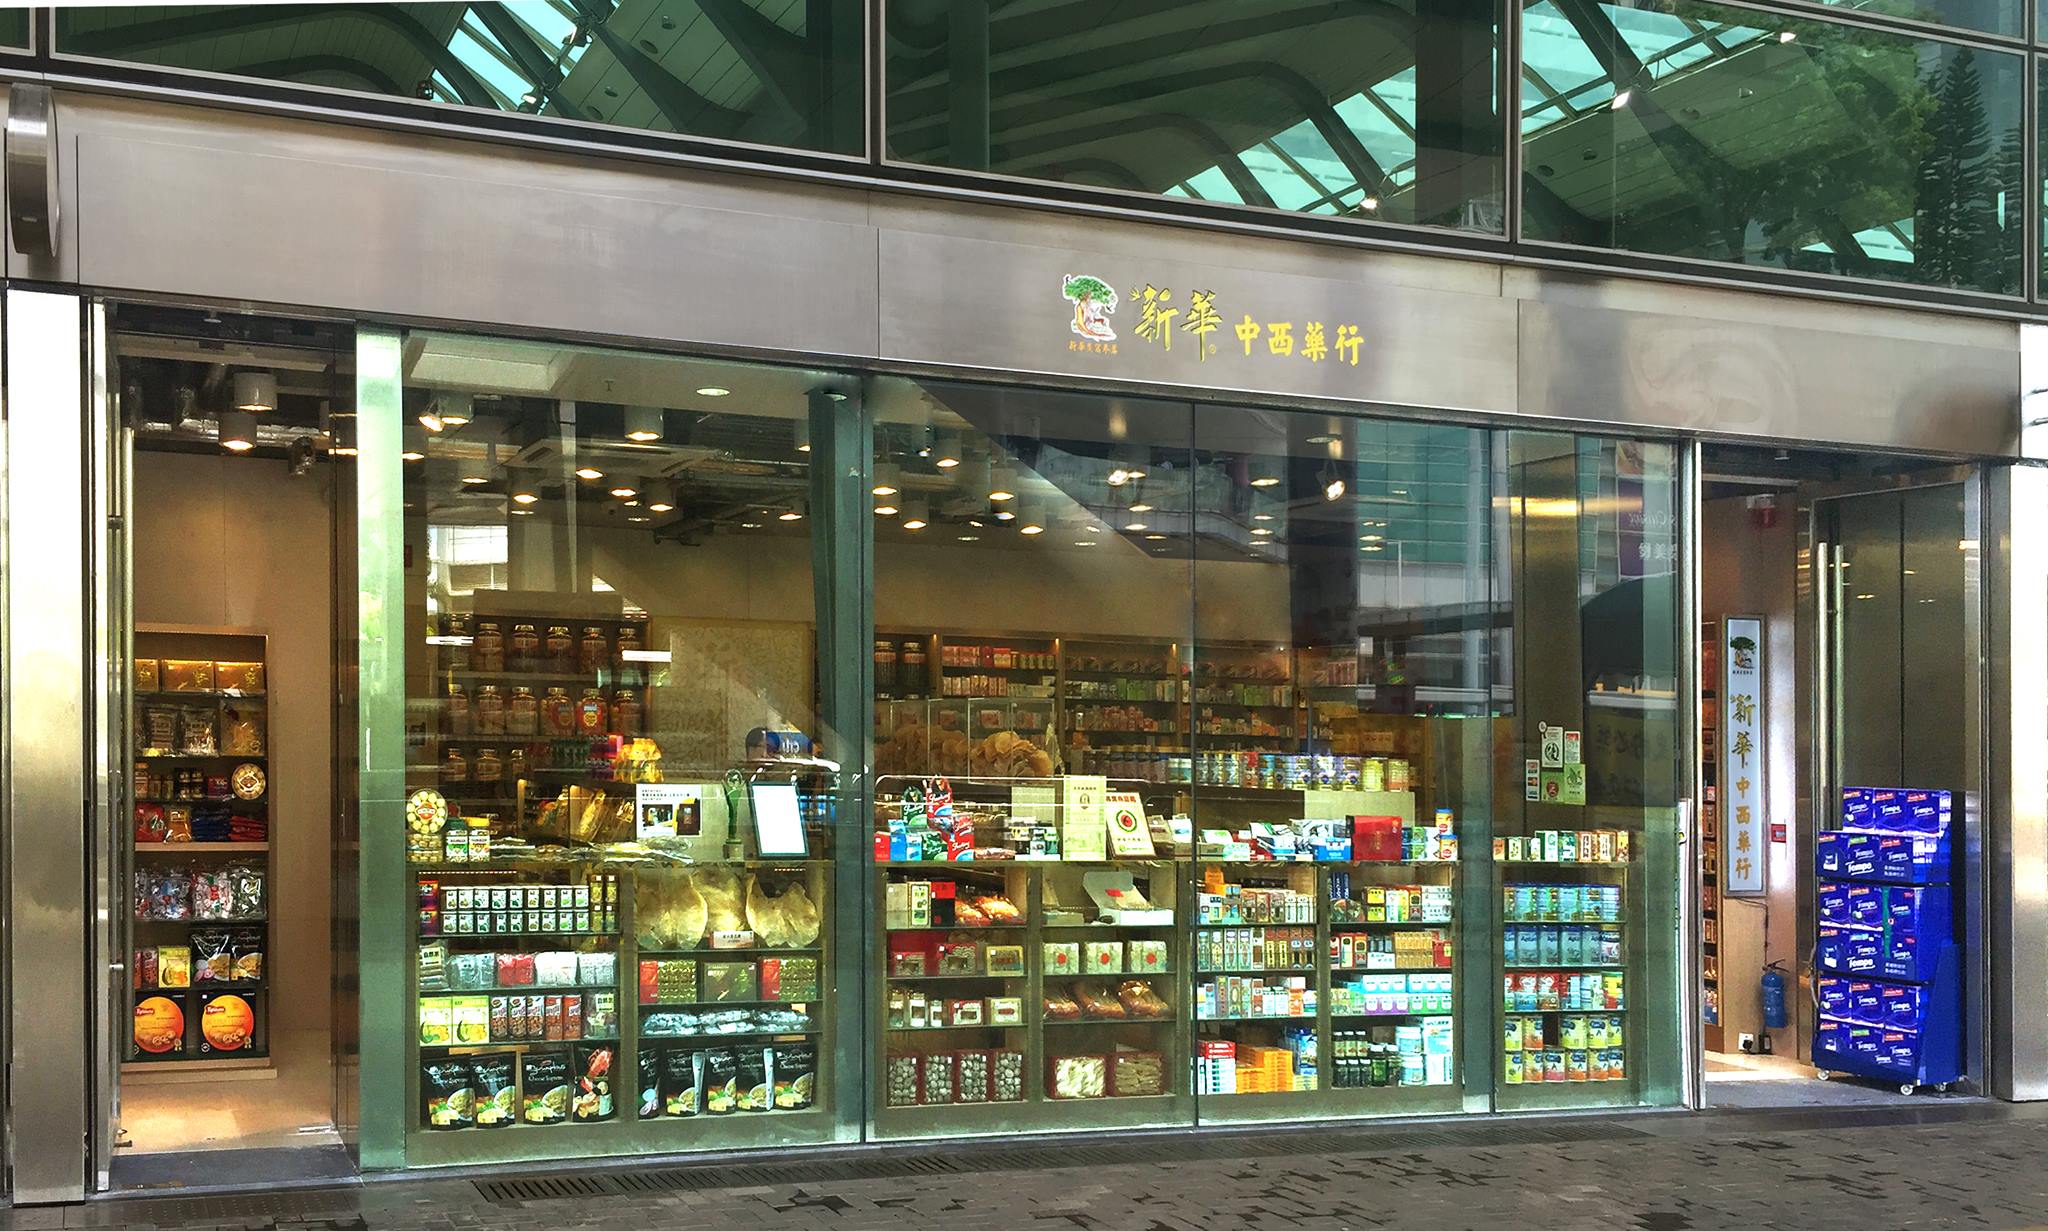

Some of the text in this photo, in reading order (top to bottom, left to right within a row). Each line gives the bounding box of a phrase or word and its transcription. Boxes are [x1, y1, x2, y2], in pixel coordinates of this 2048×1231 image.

[1128, 284, 1365, 367] 新華 中西藥行
[1731, 693, 1756, 769] 新華
[1847, 803, 1869, 813] Tempo
[1880, 805, 1902, 815] Tempo
[1912, 806, 1935, 817] Tempo
[1736, 776, 1751, 880] 中西藥行
[1854, 849, 1875, 859] Tempo
[1887, 852, 1909, 862] Tempo
[1845, 861, 1875, 876] Tempo
[1823, 898, 1844, 908] Tempo
[1856, 900, 1877, 911] Tempo
[1890, 904, 1910, 914] Tempo
[1856, 945, 1877, 956] Tempo
[1892, 950, 1912, 960] Tempo
[1847, 957, 1876, 971] Tempo
[1824, 991, 1845, 1001] Tempo
[1857, 996, 1878, 1006] Tempo
[1889, 1001, 1911, 1012] Tempo
[1856, 1041, 1878, 1052] Tempo
[1890, 1046, 1912, 1057] Tempo
